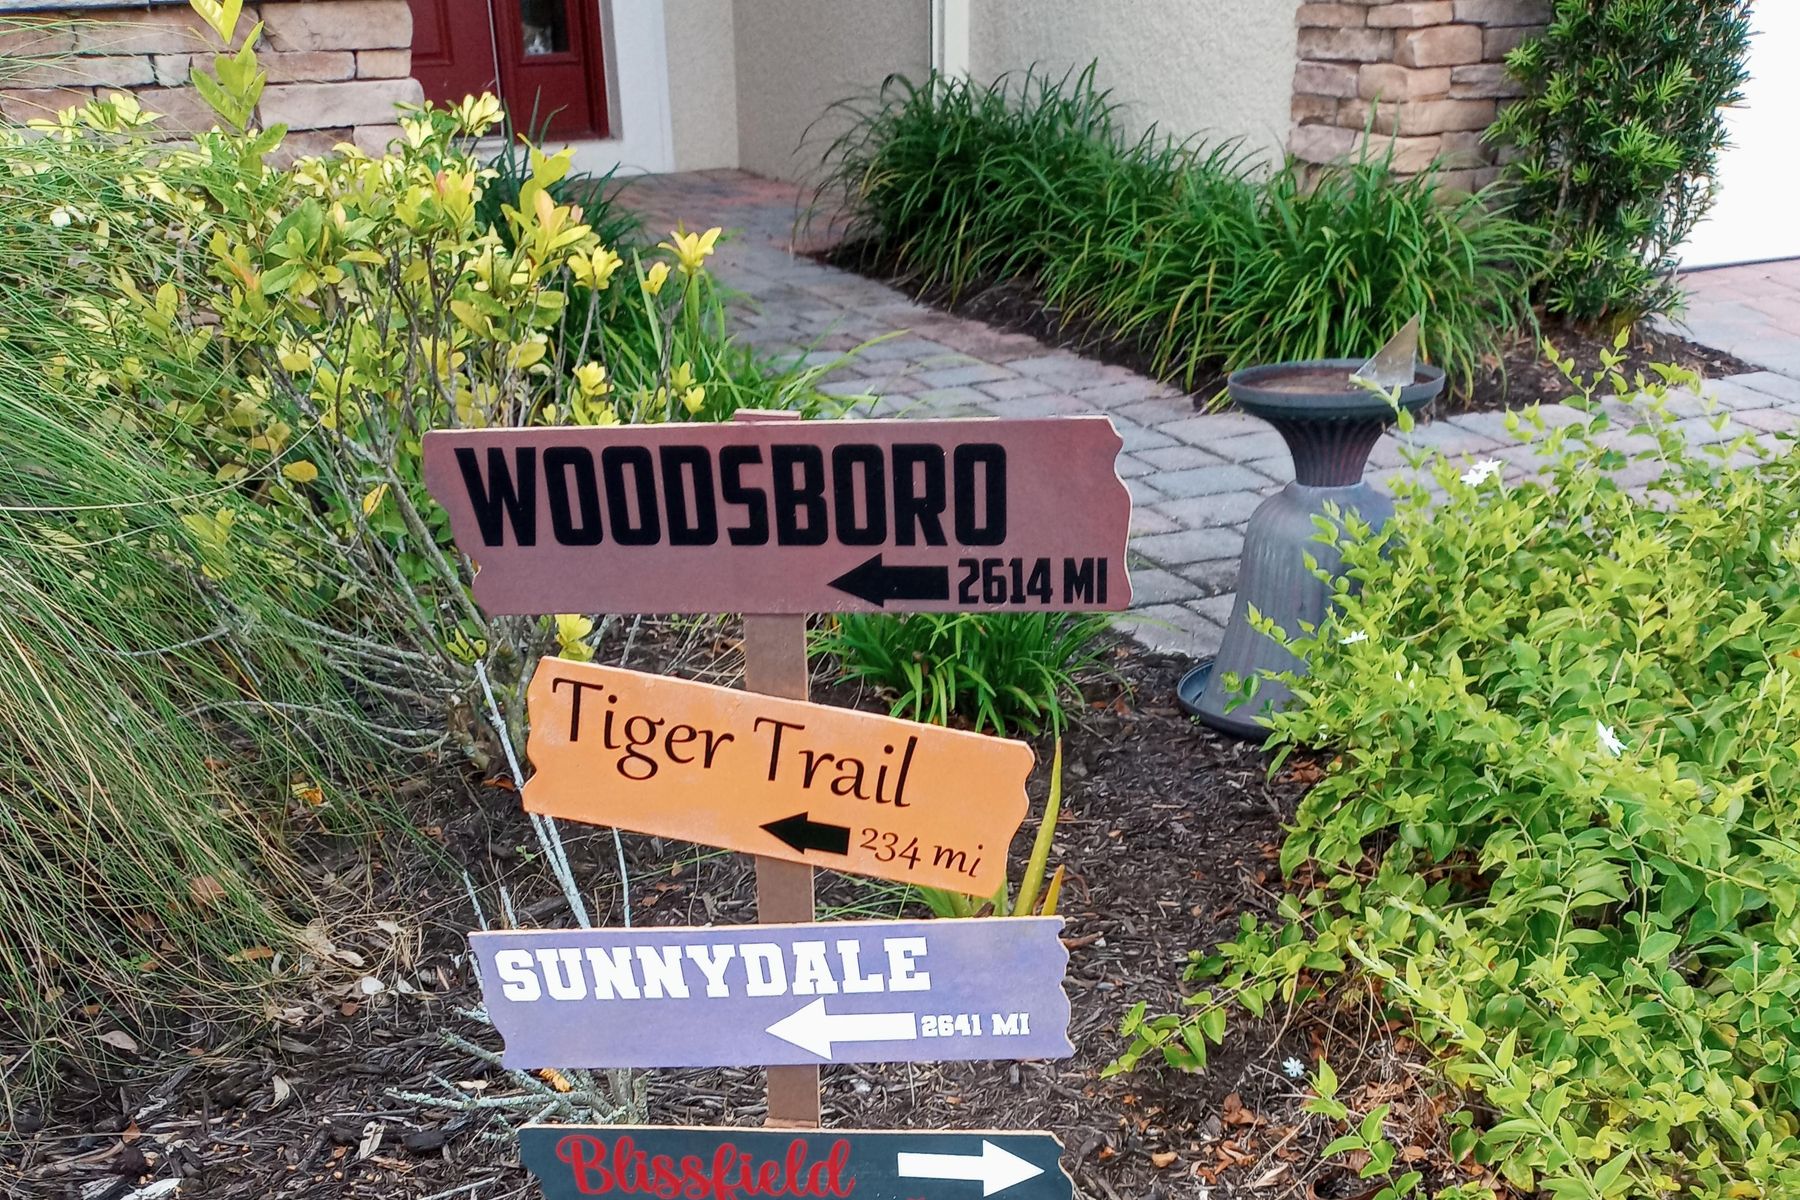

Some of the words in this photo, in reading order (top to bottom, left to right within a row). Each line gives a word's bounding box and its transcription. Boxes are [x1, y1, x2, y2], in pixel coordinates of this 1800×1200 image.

[454, 442, 1007, 548] WOODSBORO
[957, 557, 1052, 604] 2614
[1063, 557, 1107, 603] MI
[551, 677, 735, 781] Tiger
[753, 716, 918, 808] Trail
[859, 827, 921, 871] 234
[933, 843, 983, 878] mi
[494, 936, 932, 1002] SUNNYDALE
[920, 1014, 982, 1038] 2641
[992, 1012, 1030, 1036] MI
